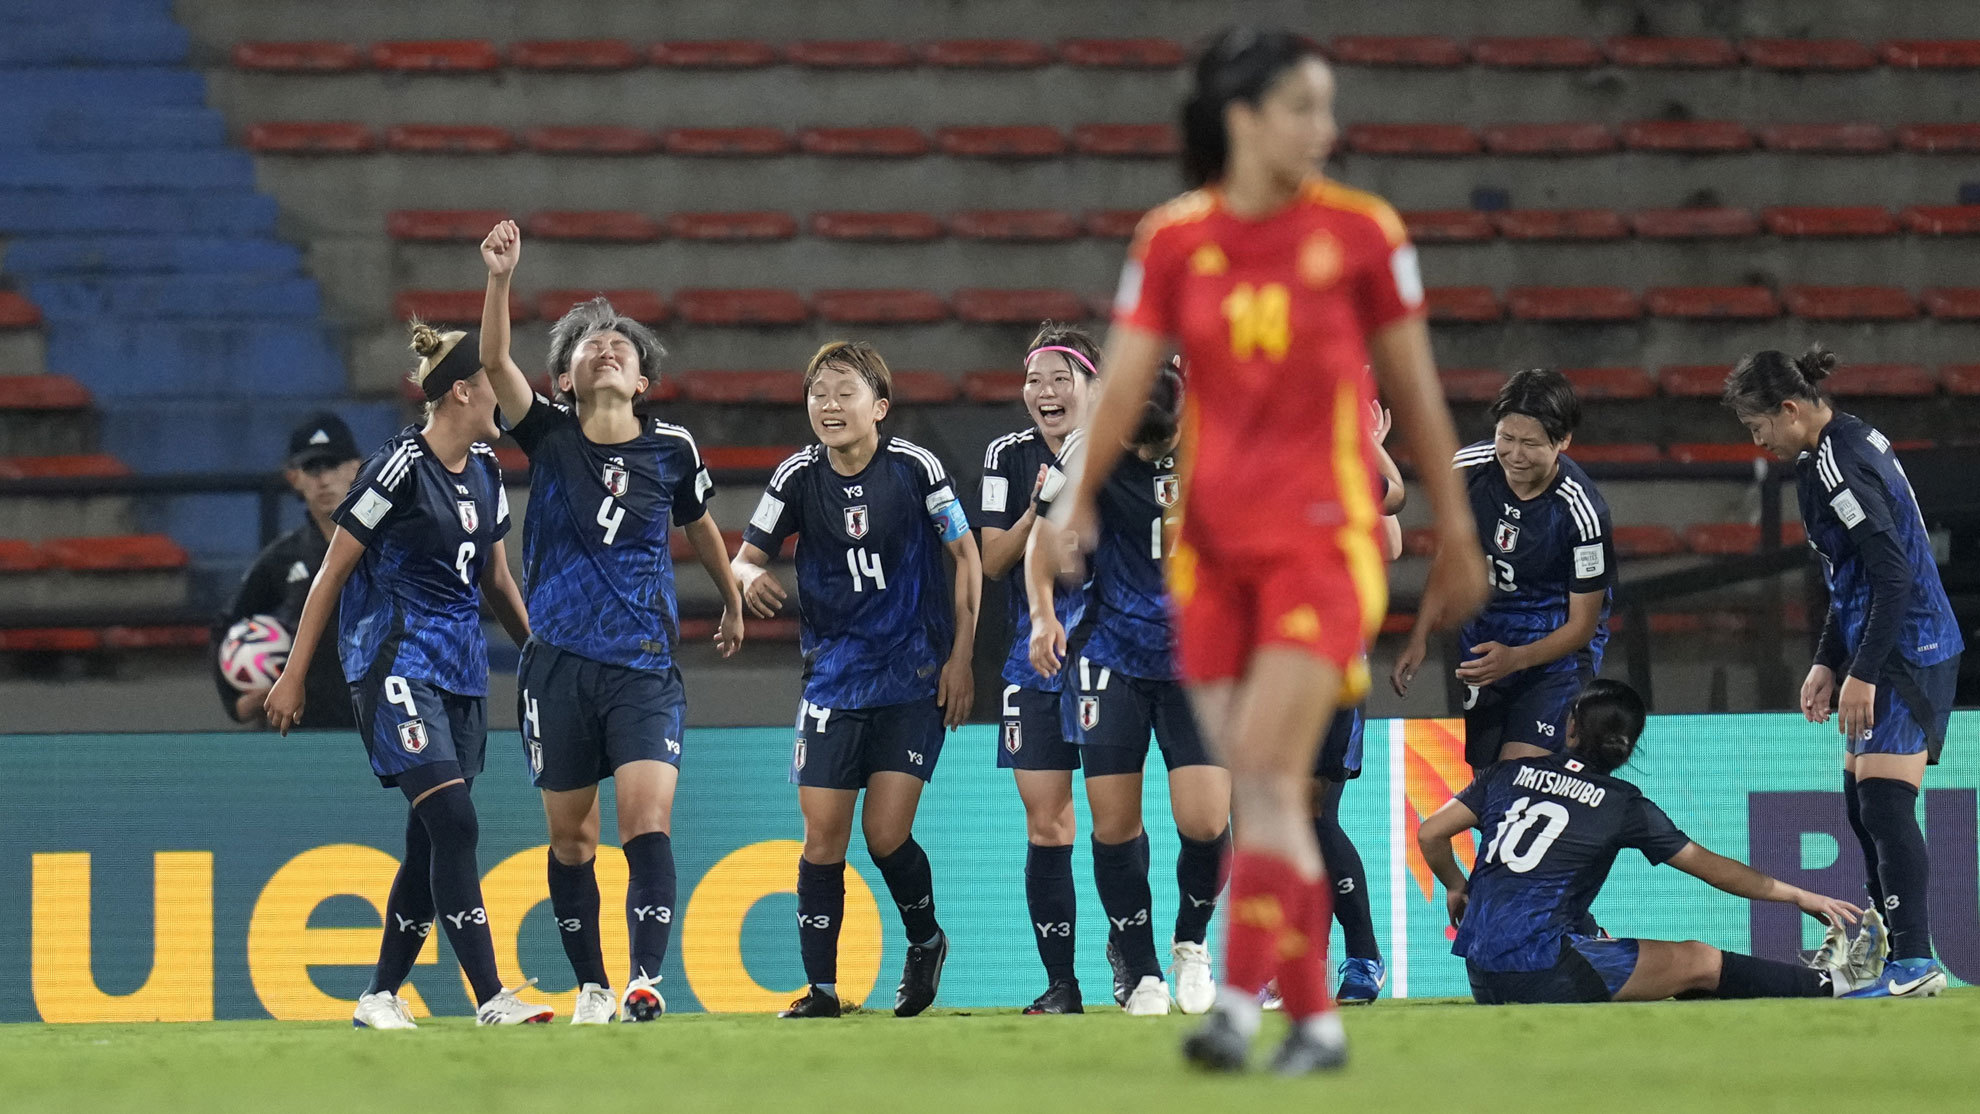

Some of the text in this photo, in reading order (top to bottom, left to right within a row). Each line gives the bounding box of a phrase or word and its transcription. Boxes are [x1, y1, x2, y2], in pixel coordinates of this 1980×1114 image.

[843, 485, 864, 499] Y-3
[597, 496, 626, 545] 4
[1504, 503, 1520, 519] Y-3
[456, 542, 476, 584] 9
[847, 548, 886, 592] 14
[384, 676, 417, 716] 9
[524, 689, 541, 738] 4
[1536, 721, 1555, 737] Y-3
[665, 738, 680, 754] Y-3
[907, 750, 923, 765] Y-3
[1513, 765, 1605, 807] MATSUKUBO
[1485, 797, 1569, 873] 10
[395, 912, 433, 937] Y-3
[446, 907, 487, 929] Y-3
[555, 917, 581, 932] -3
[634, 905, 671, 923] Y-3
[796, 912, 830, 929] Y-3
[1110, 908, 1147, 931] Y-3
[1037, 922, 1070, 938] Y-3
